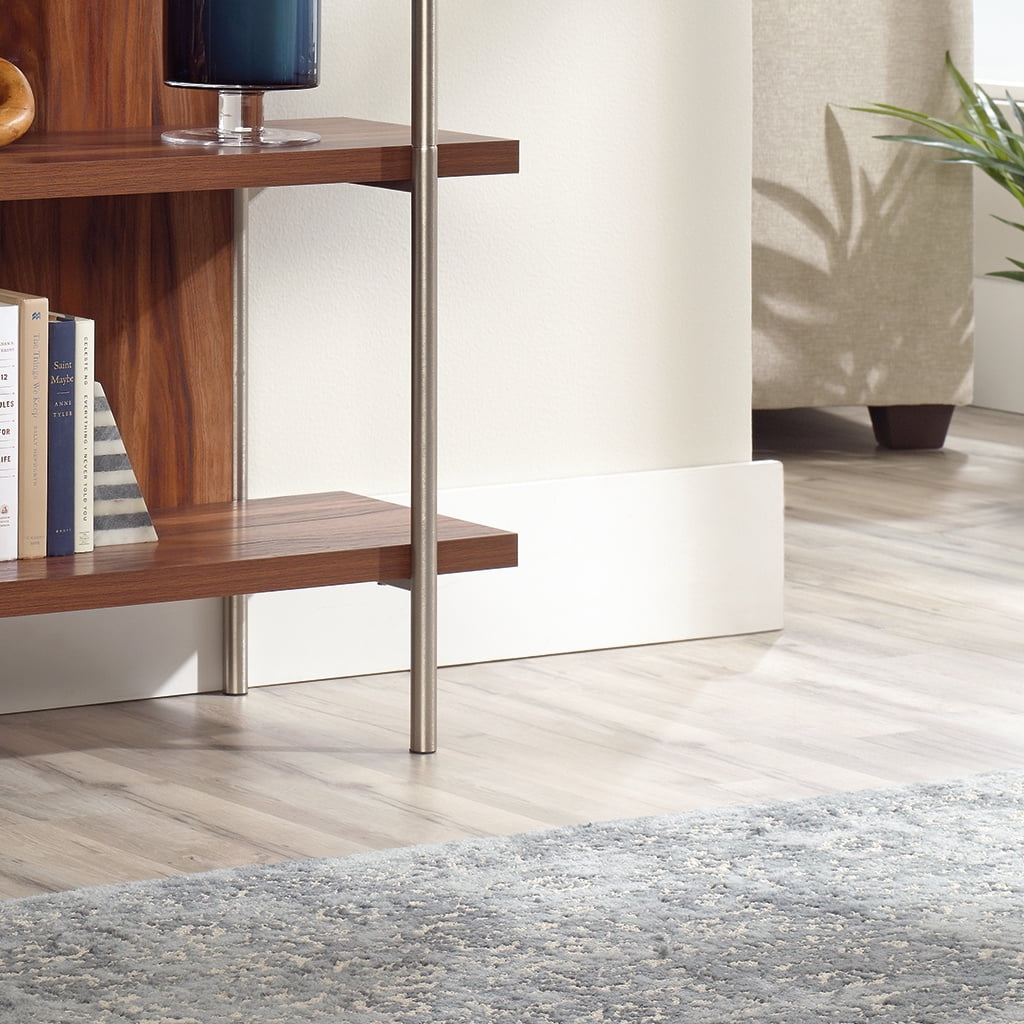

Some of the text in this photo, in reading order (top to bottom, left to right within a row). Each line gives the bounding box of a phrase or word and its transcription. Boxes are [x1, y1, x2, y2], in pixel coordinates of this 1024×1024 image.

[54, 361, 72, 370] Saint
[31, 333, 41, 417] The Things We Keep
[51, 375, 74, 386] Maybe
[83, 375, 89, 386] NG
